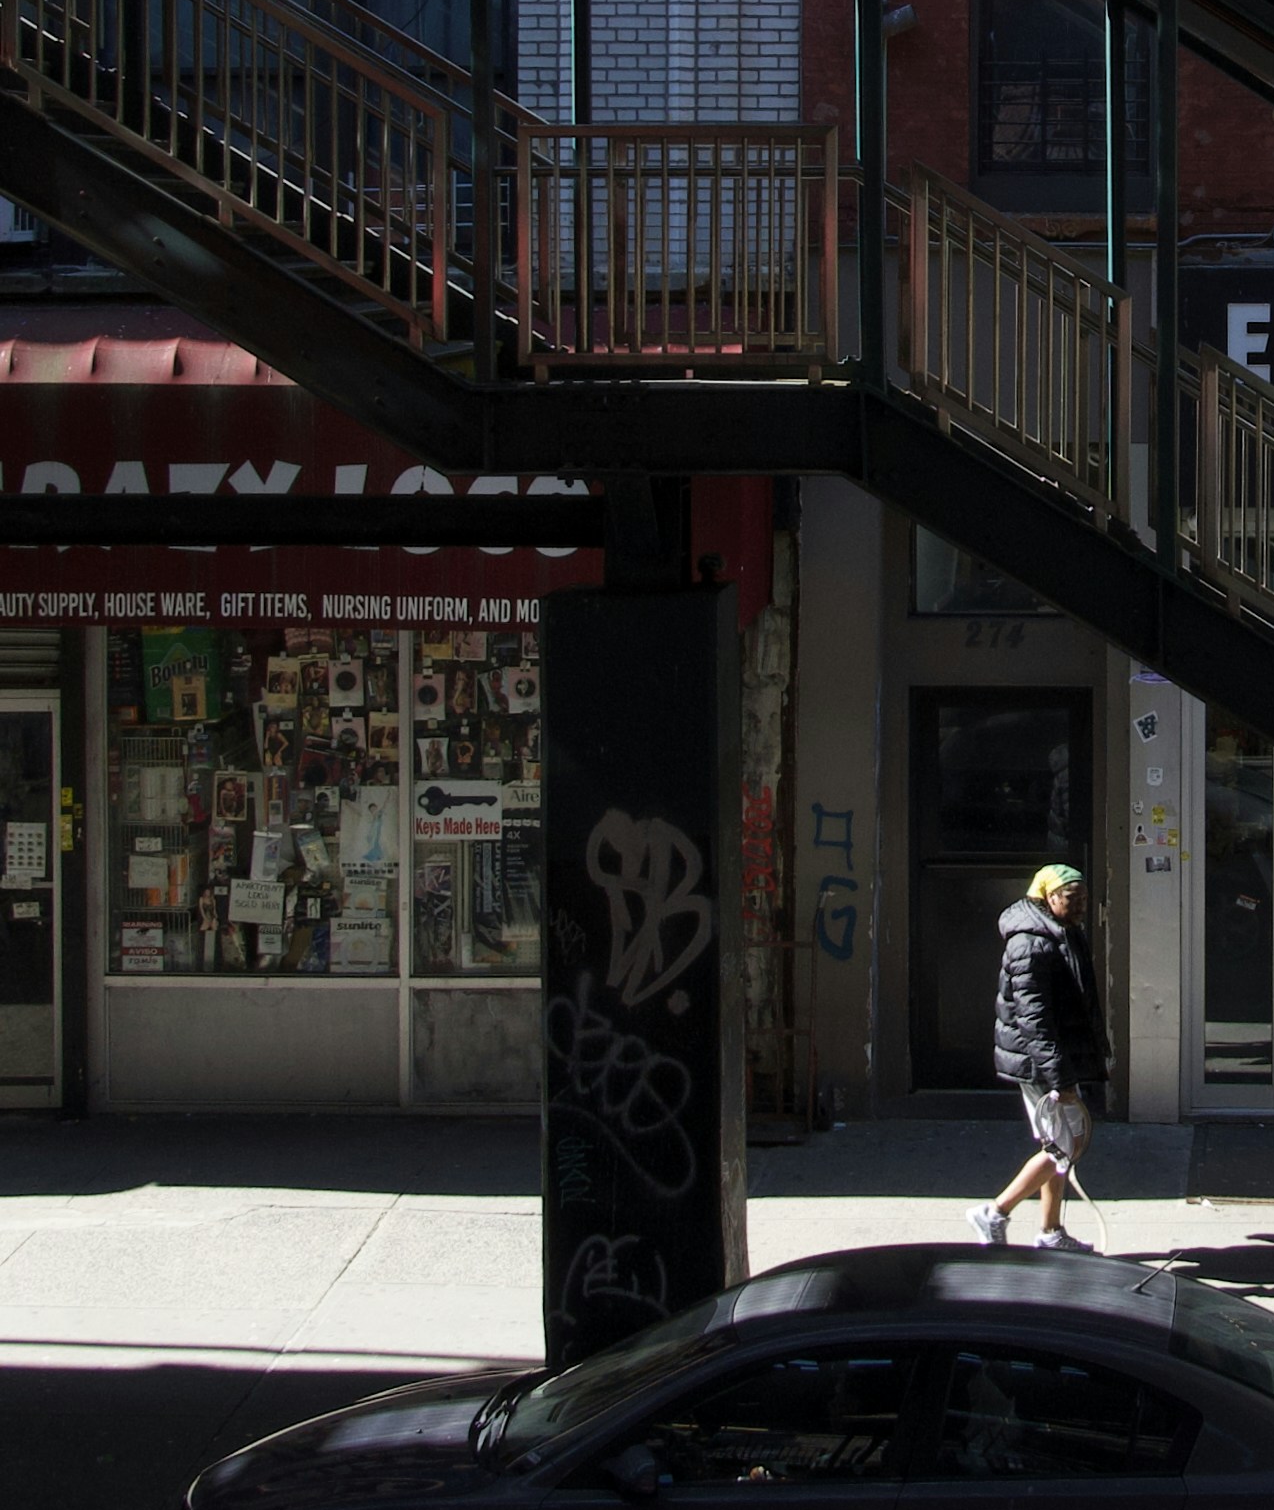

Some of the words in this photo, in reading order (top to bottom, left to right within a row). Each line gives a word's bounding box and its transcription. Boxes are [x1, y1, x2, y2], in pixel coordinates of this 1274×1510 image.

[38, 592, 99, 619] SUPPLY,
[105, 593, 156, 617] HOUSE
[161, 593, 211, 619] WARE,
[221, 593, 255, 617] GIFT
[260, 593, 312, 620] ITEMS,
[323, 594, 391, 620] NURSING
[396, 596, 473, 624] UNIFORM,
[478, 598, 511, 623] AND
[415, 817, 441, 838] Keys
[443, 817, 472, 836] Made
[476, 818, 500, 835] Here
